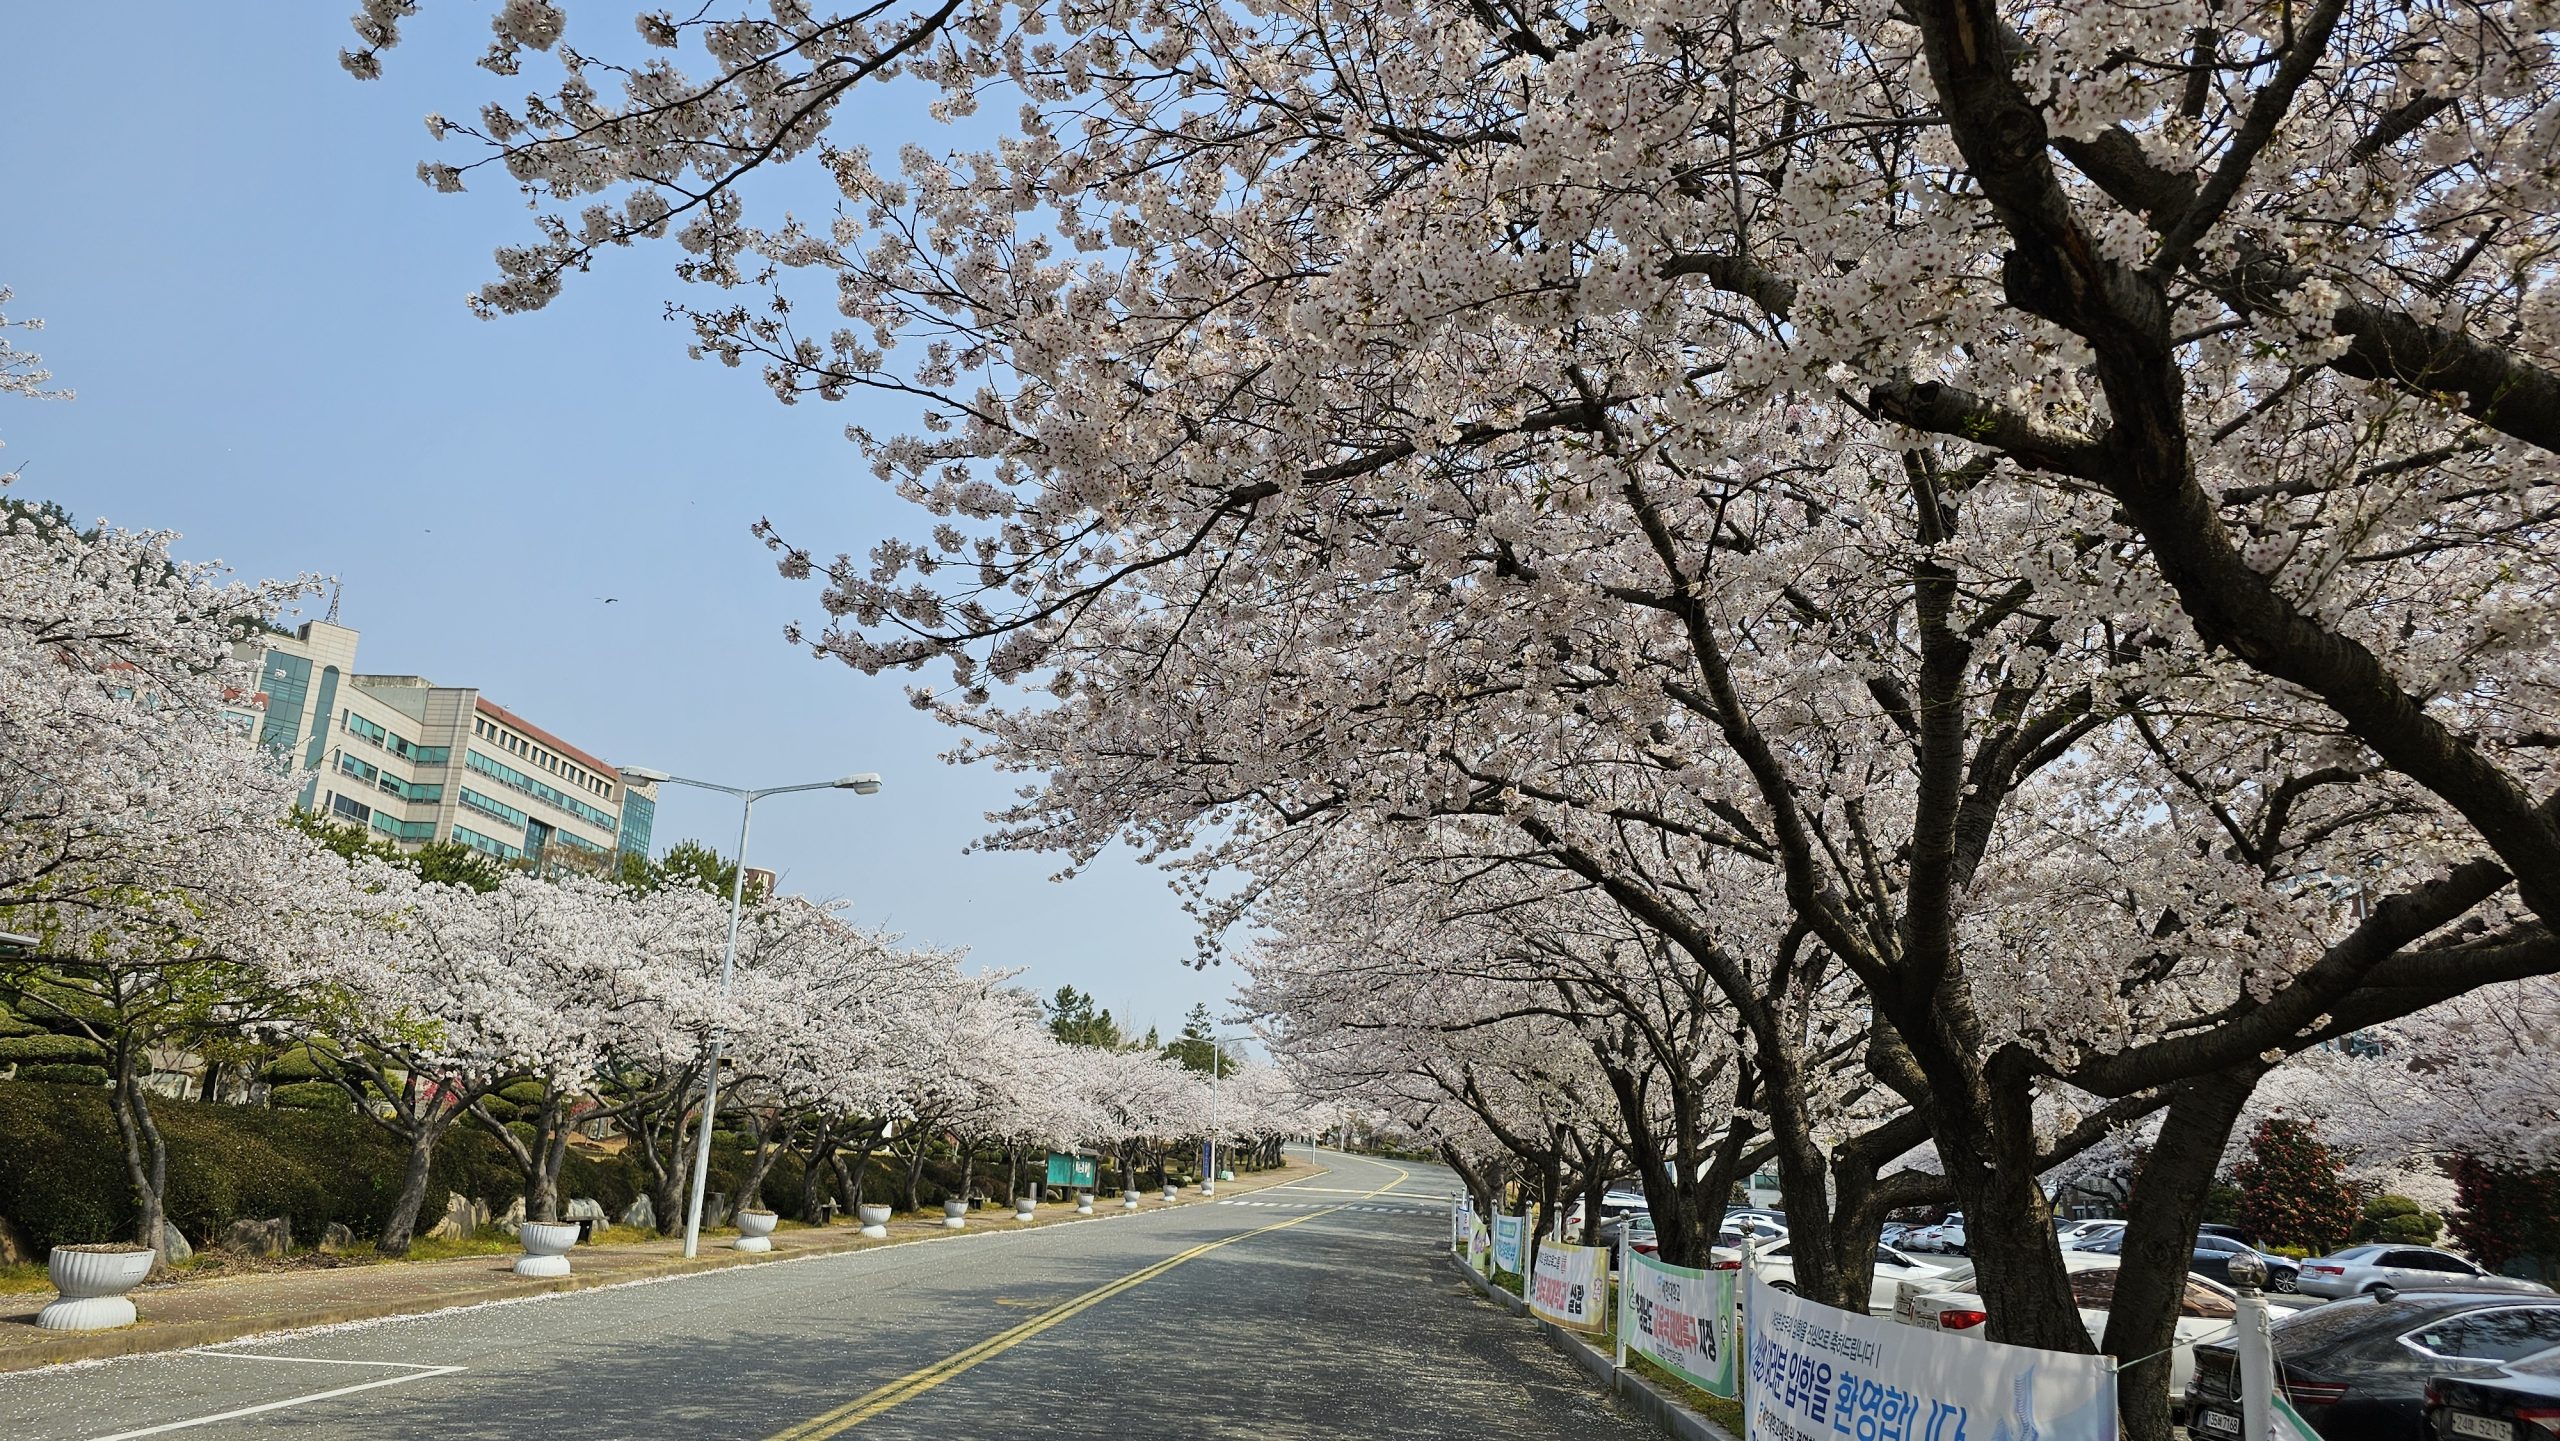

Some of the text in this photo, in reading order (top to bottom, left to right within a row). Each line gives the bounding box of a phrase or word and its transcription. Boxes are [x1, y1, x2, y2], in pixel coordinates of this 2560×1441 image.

[1698, 1318, 1717, 1362] 지정
[1792, 1319, 1808, 1342] 입학을
[1806, 1324, 1831, 1350] 진심으로
[1784, 1352, 1832, 1424] 입학을
[1833, 1371, 1967, 1441] 환영합니다
